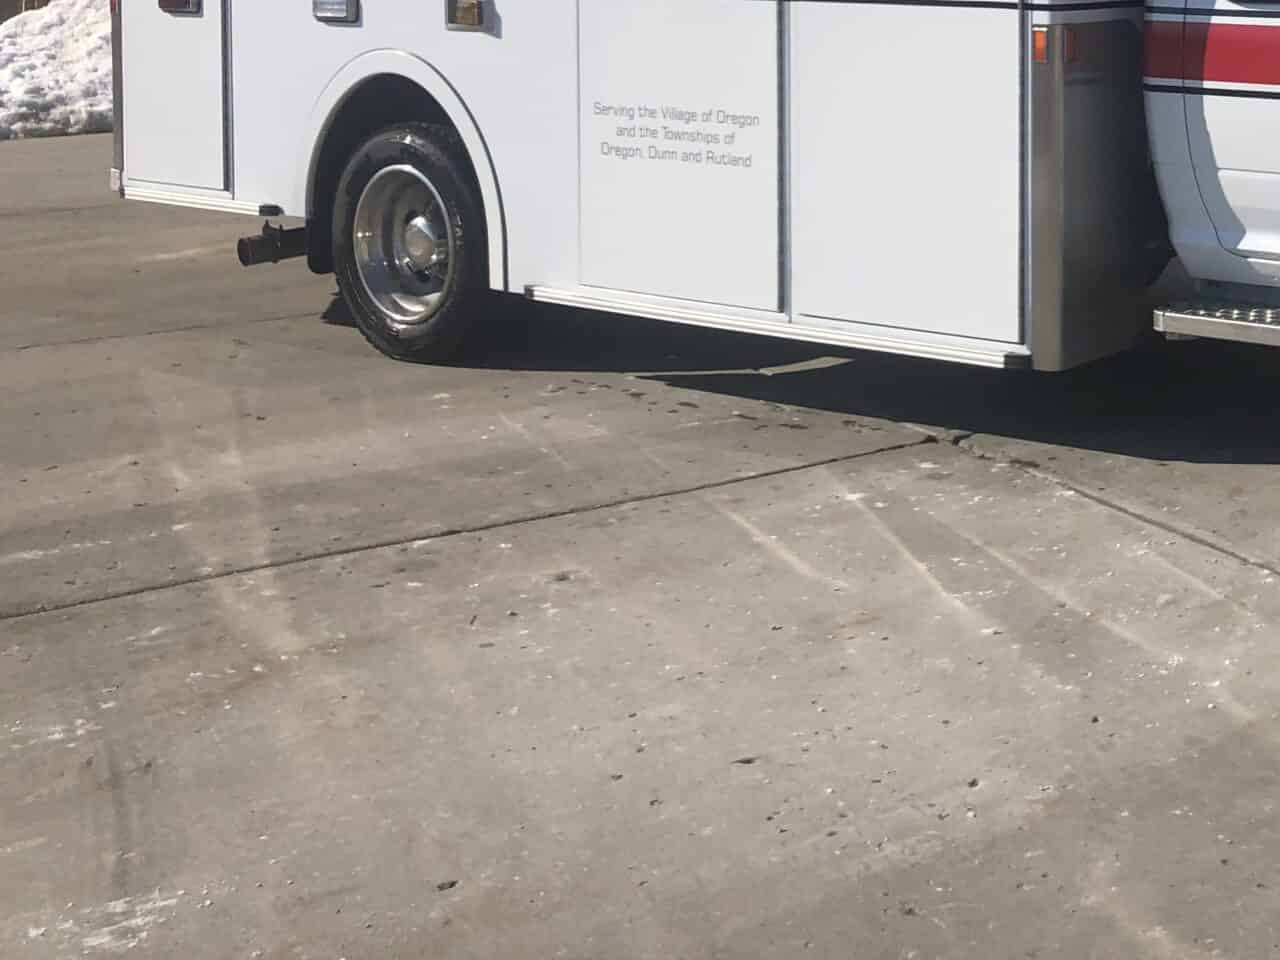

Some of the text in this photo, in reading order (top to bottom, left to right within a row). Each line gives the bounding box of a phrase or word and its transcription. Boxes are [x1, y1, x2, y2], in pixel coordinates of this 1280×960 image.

[593, 101, 760, 128] Serving the Village of Oregon
[616, 124, 736, 145] and the Townships of
[648, 145, 678, 161] Dunn
[681, 148, 702, 163] and
[706, 151, 752, 168] Rutland
